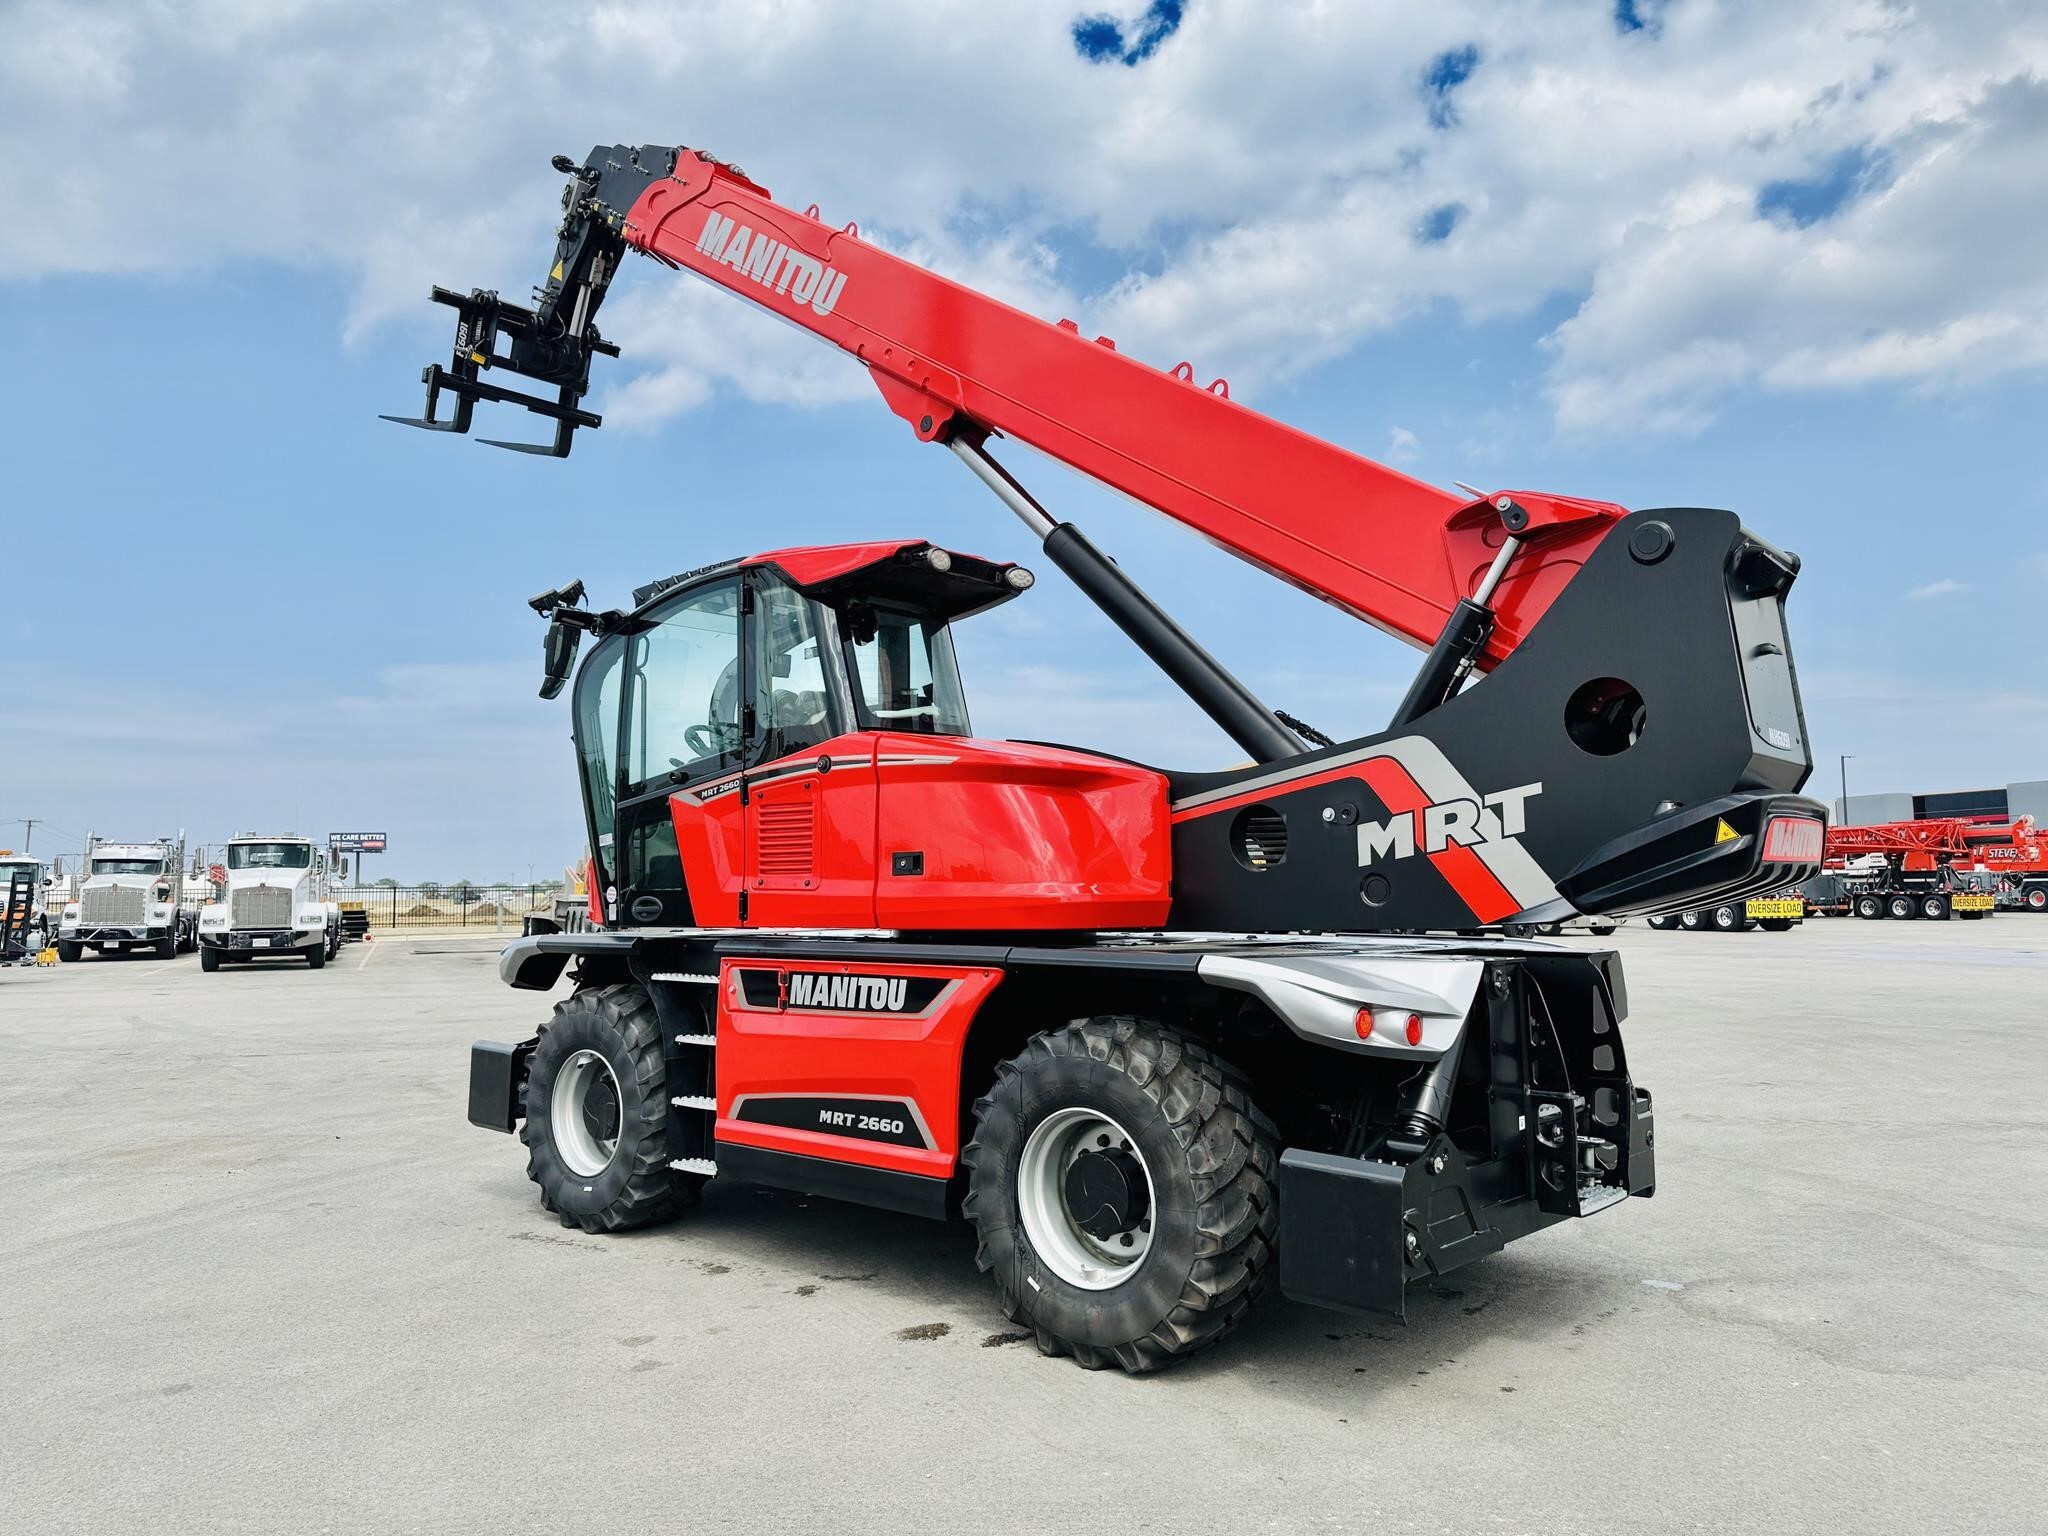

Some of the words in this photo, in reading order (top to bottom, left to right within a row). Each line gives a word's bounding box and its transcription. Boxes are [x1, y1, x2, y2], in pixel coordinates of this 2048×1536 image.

[695, 210, 848, 316] MANITOU
[701, 787, 718, 799] MRT
[719, 780, 740, 792] 2660
[1356, 781, 1543, 868] MRT
[1747, 903, 1782, 914] OVERSIZE
[1783, 903, 1802, 914] LOAD
[1952, 898, 1978, 907] OVERSIZE
[1978, 898, 1994, 907] LOAD
[789, 974, 908, 1011] MANITOU
[819, 1109, 856, 1127] MRT
[857, 1115, 905, 1134] 2660
